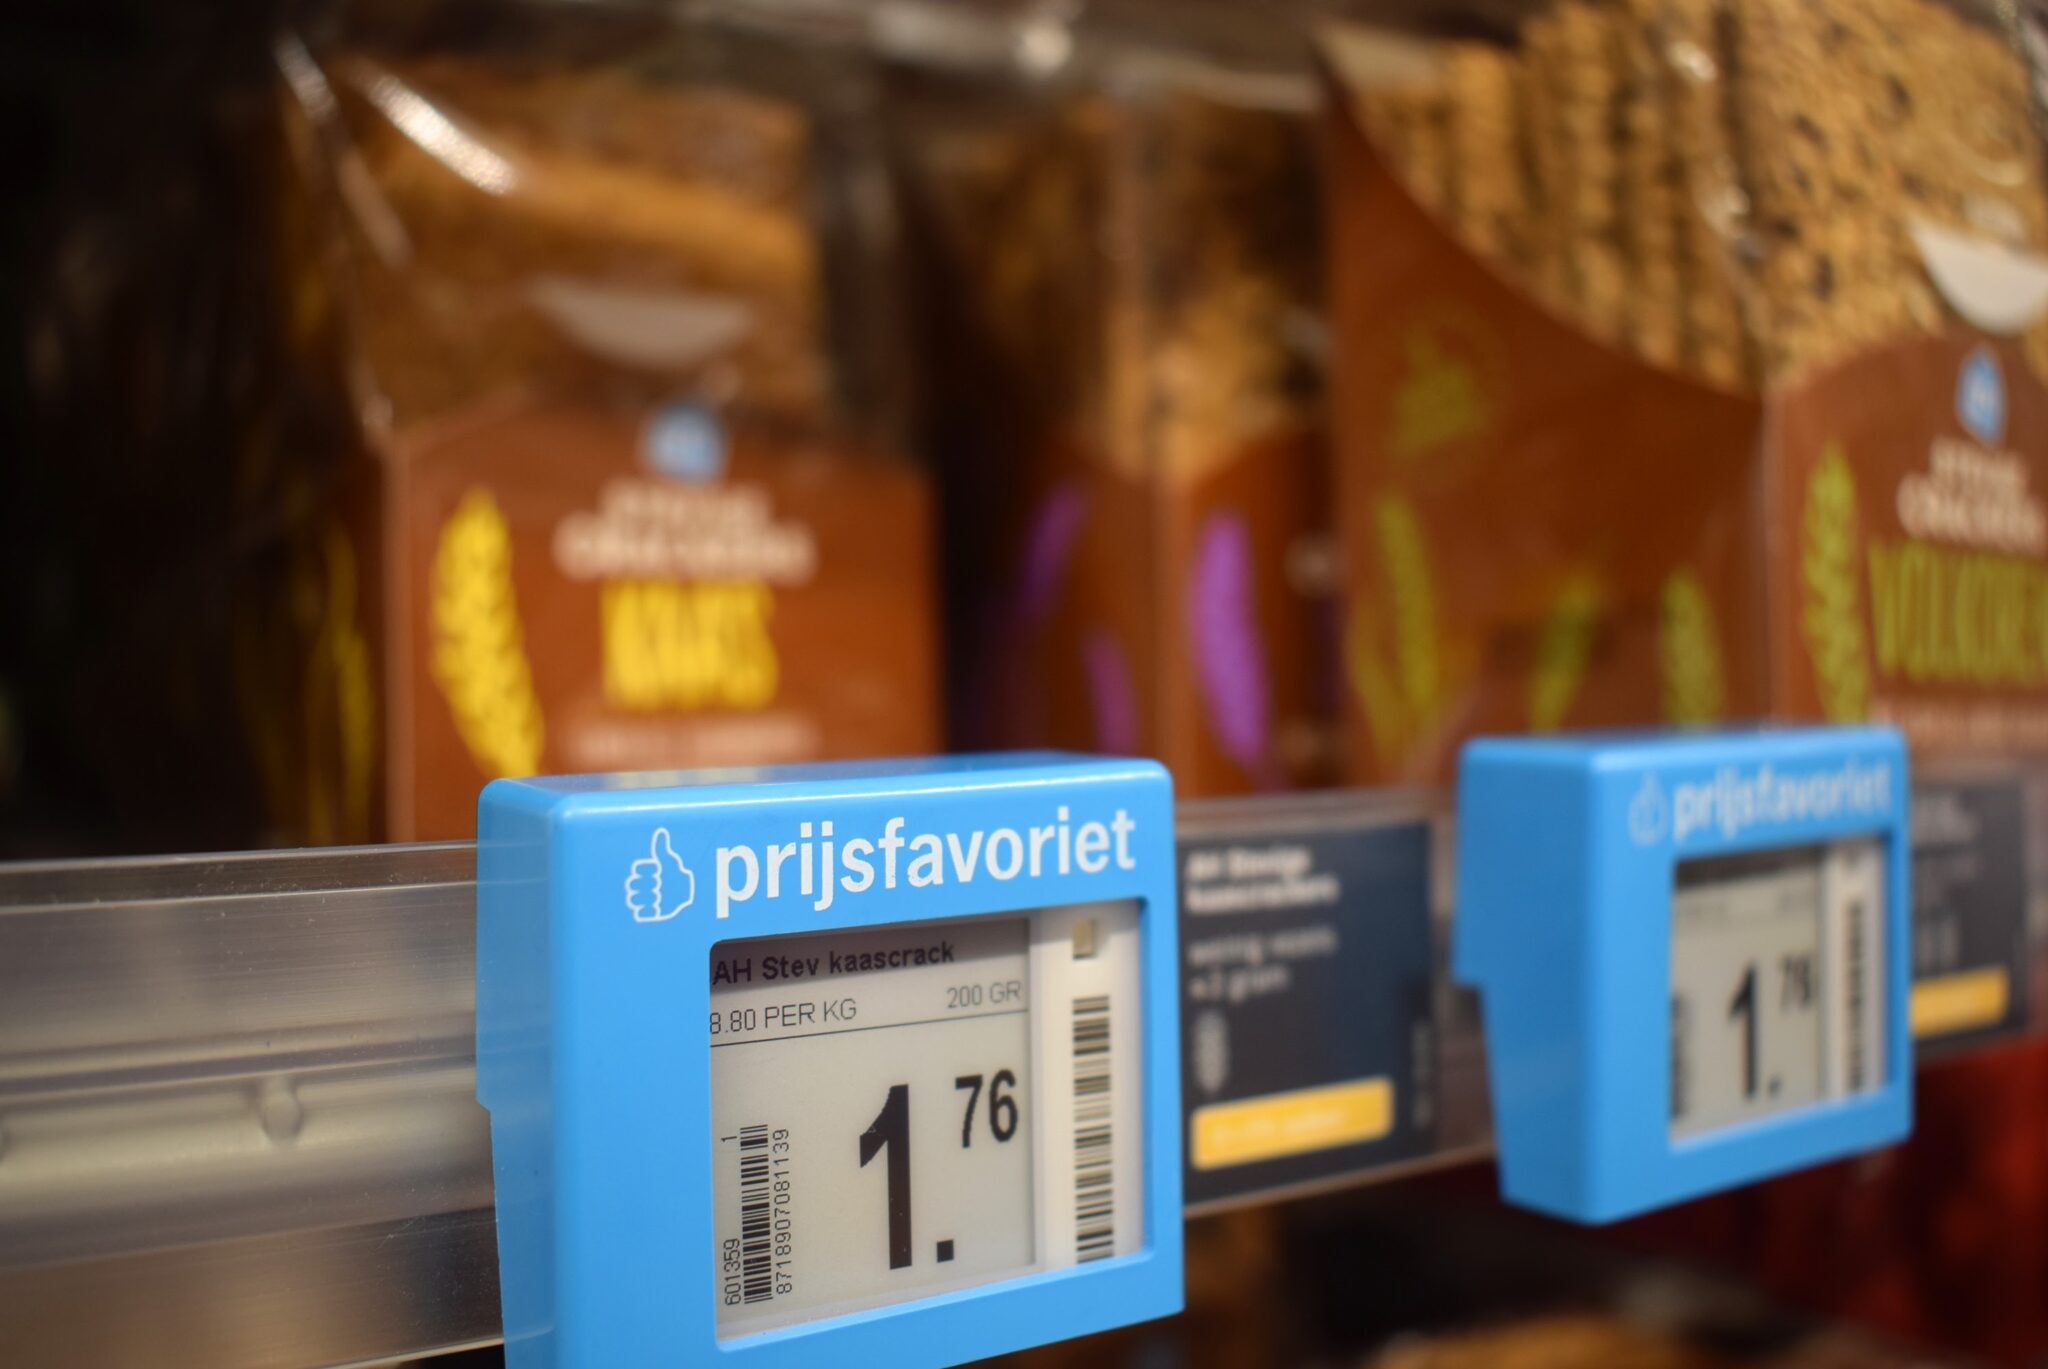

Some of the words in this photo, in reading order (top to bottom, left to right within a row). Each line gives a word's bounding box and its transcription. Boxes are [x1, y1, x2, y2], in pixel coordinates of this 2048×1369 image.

[715, 806, 1136, 918] prijsfavoriet
[712, 958, 751, 986] AH
[762, 956, 819, 981] Stev
[829, 941, 955, 974] kaascrack
[710, 1008, 756, 1035] 8.80
[765, 1002, 816, 1028] PER
[824, 998, 857, 1022] KG
[946, 983, 983, 1010] 200
[989, 980, 1022, 1004] GR
[772, 1128, 793, 1295] 8718907081139
[724, 1238, 742, 1306] 601359
